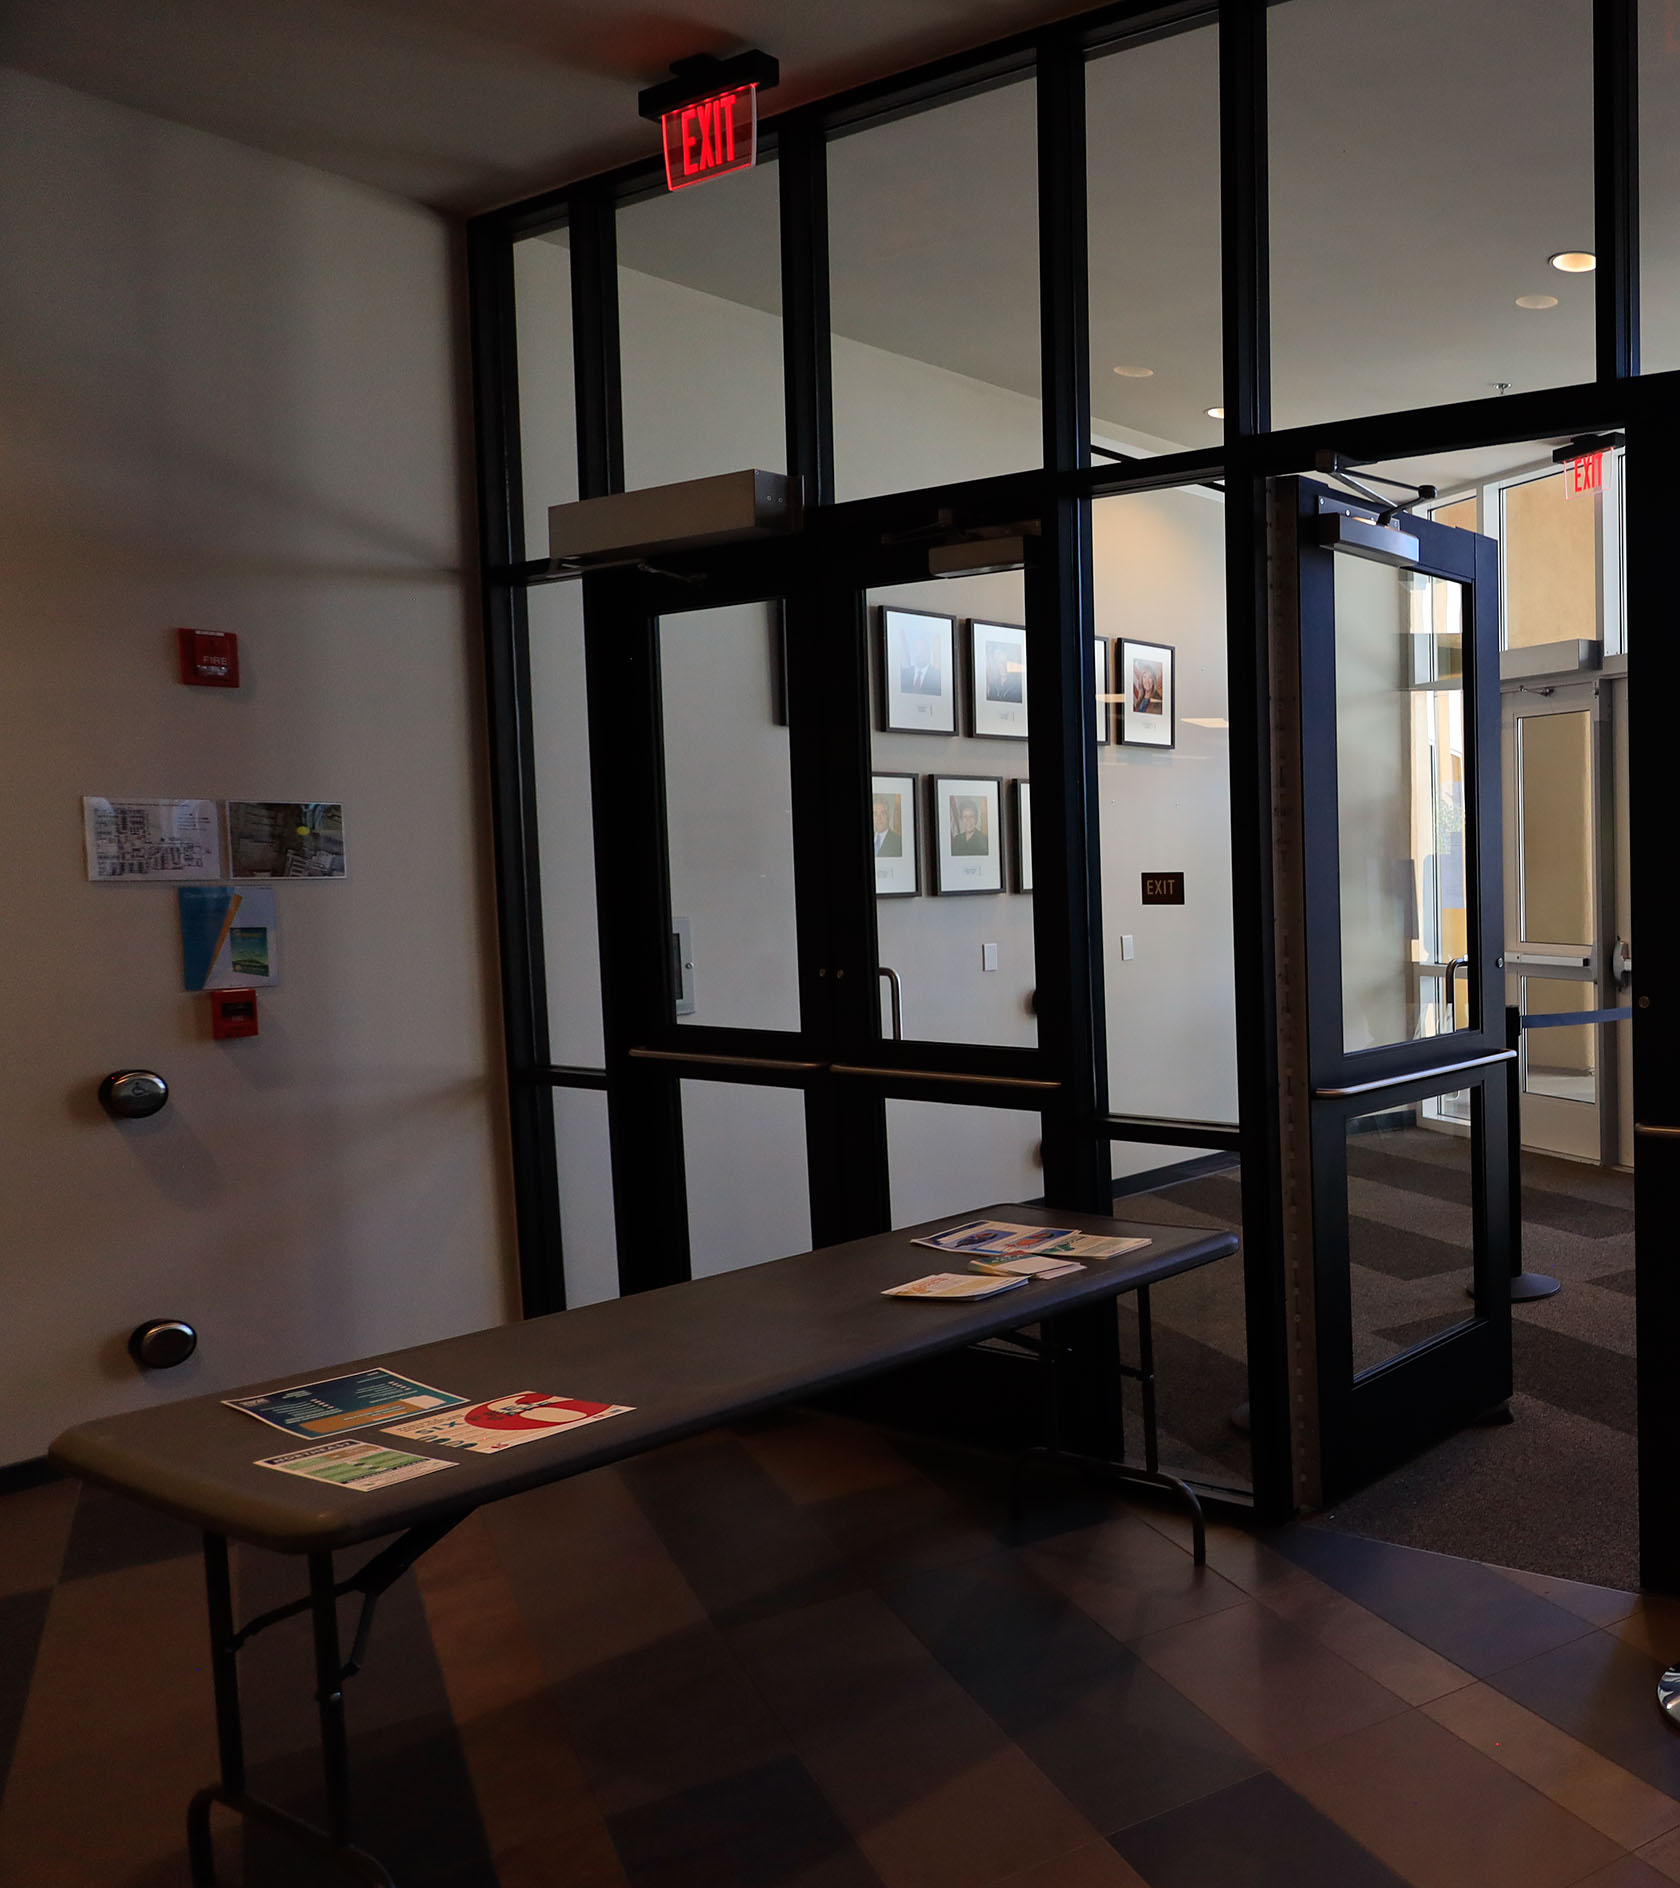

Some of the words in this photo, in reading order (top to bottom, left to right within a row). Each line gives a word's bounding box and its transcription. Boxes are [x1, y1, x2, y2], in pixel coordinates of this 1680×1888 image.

[681, 94, 736, 176] EXIT
[1574, 452, 1603, 493] EXIT
[203, 655, 228, 665] FIRE
[1146, 880, 1175, 895] EXIT
[415, 1421, 465, 1435] SIX
